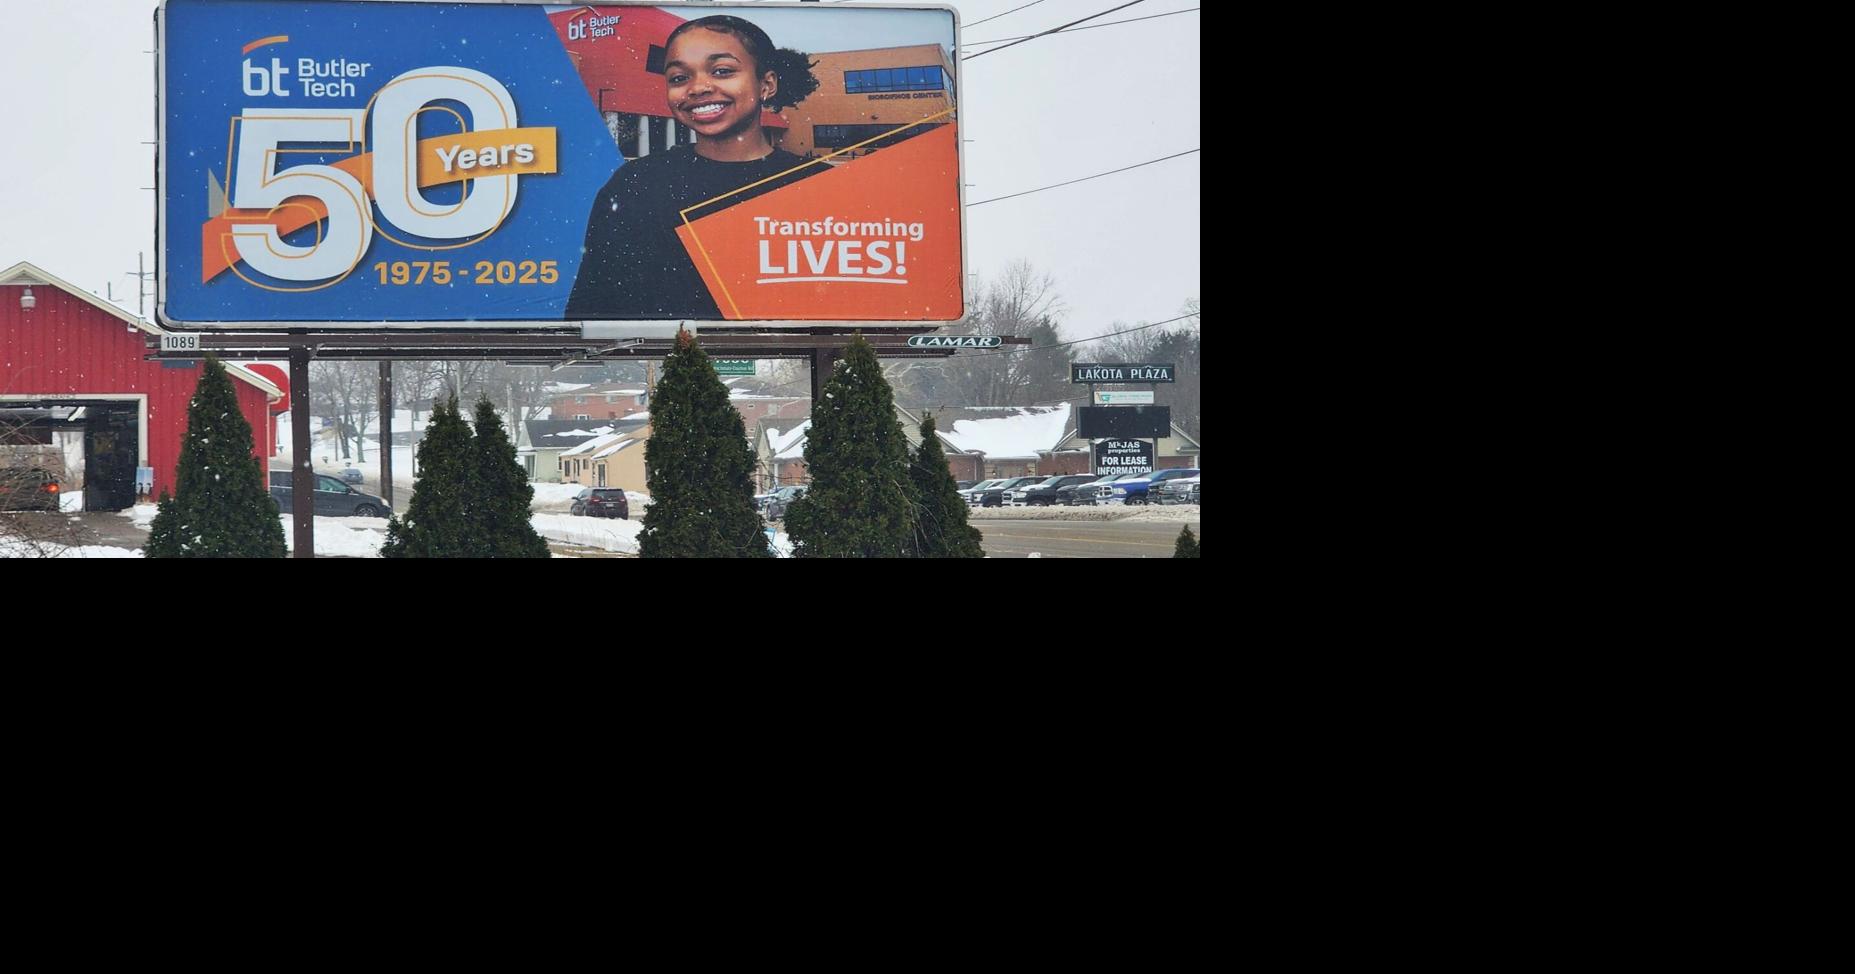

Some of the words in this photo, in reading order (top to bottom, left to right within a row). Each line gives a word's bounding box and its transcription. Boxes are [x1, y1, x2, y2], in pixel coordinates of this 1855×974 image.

[568, 19, 587, 40] bt
[590, 15, 620, 27] Butler
[590, 26, 614, 37] Tech
[242, 57, 290, 97] bt
[298, 57, 371, 77] Butler
[298, 77, 355, 97] Tech
[434, 143, 534, 172] Years
[231, 66, 518, 282] 50
[753, 216, 924, 241] Transforming
[759, 239, 907, 275] LIVES!
[374, 261, 451, 285] 1975
[475, 261, 559, 284] 2025
[165, 336, 195, 349] 1089
[916, 337, 993, 347] LAMAR
[1078, 368, 1123, 379] LAKOTA
[1130, 368, 1168, 379] PLAZA
[1097, 466, 1152, 475] INFORMATION
[1101, 456, 1119, 465] FOR
[1120, 456, 1147, 465] LEASE
